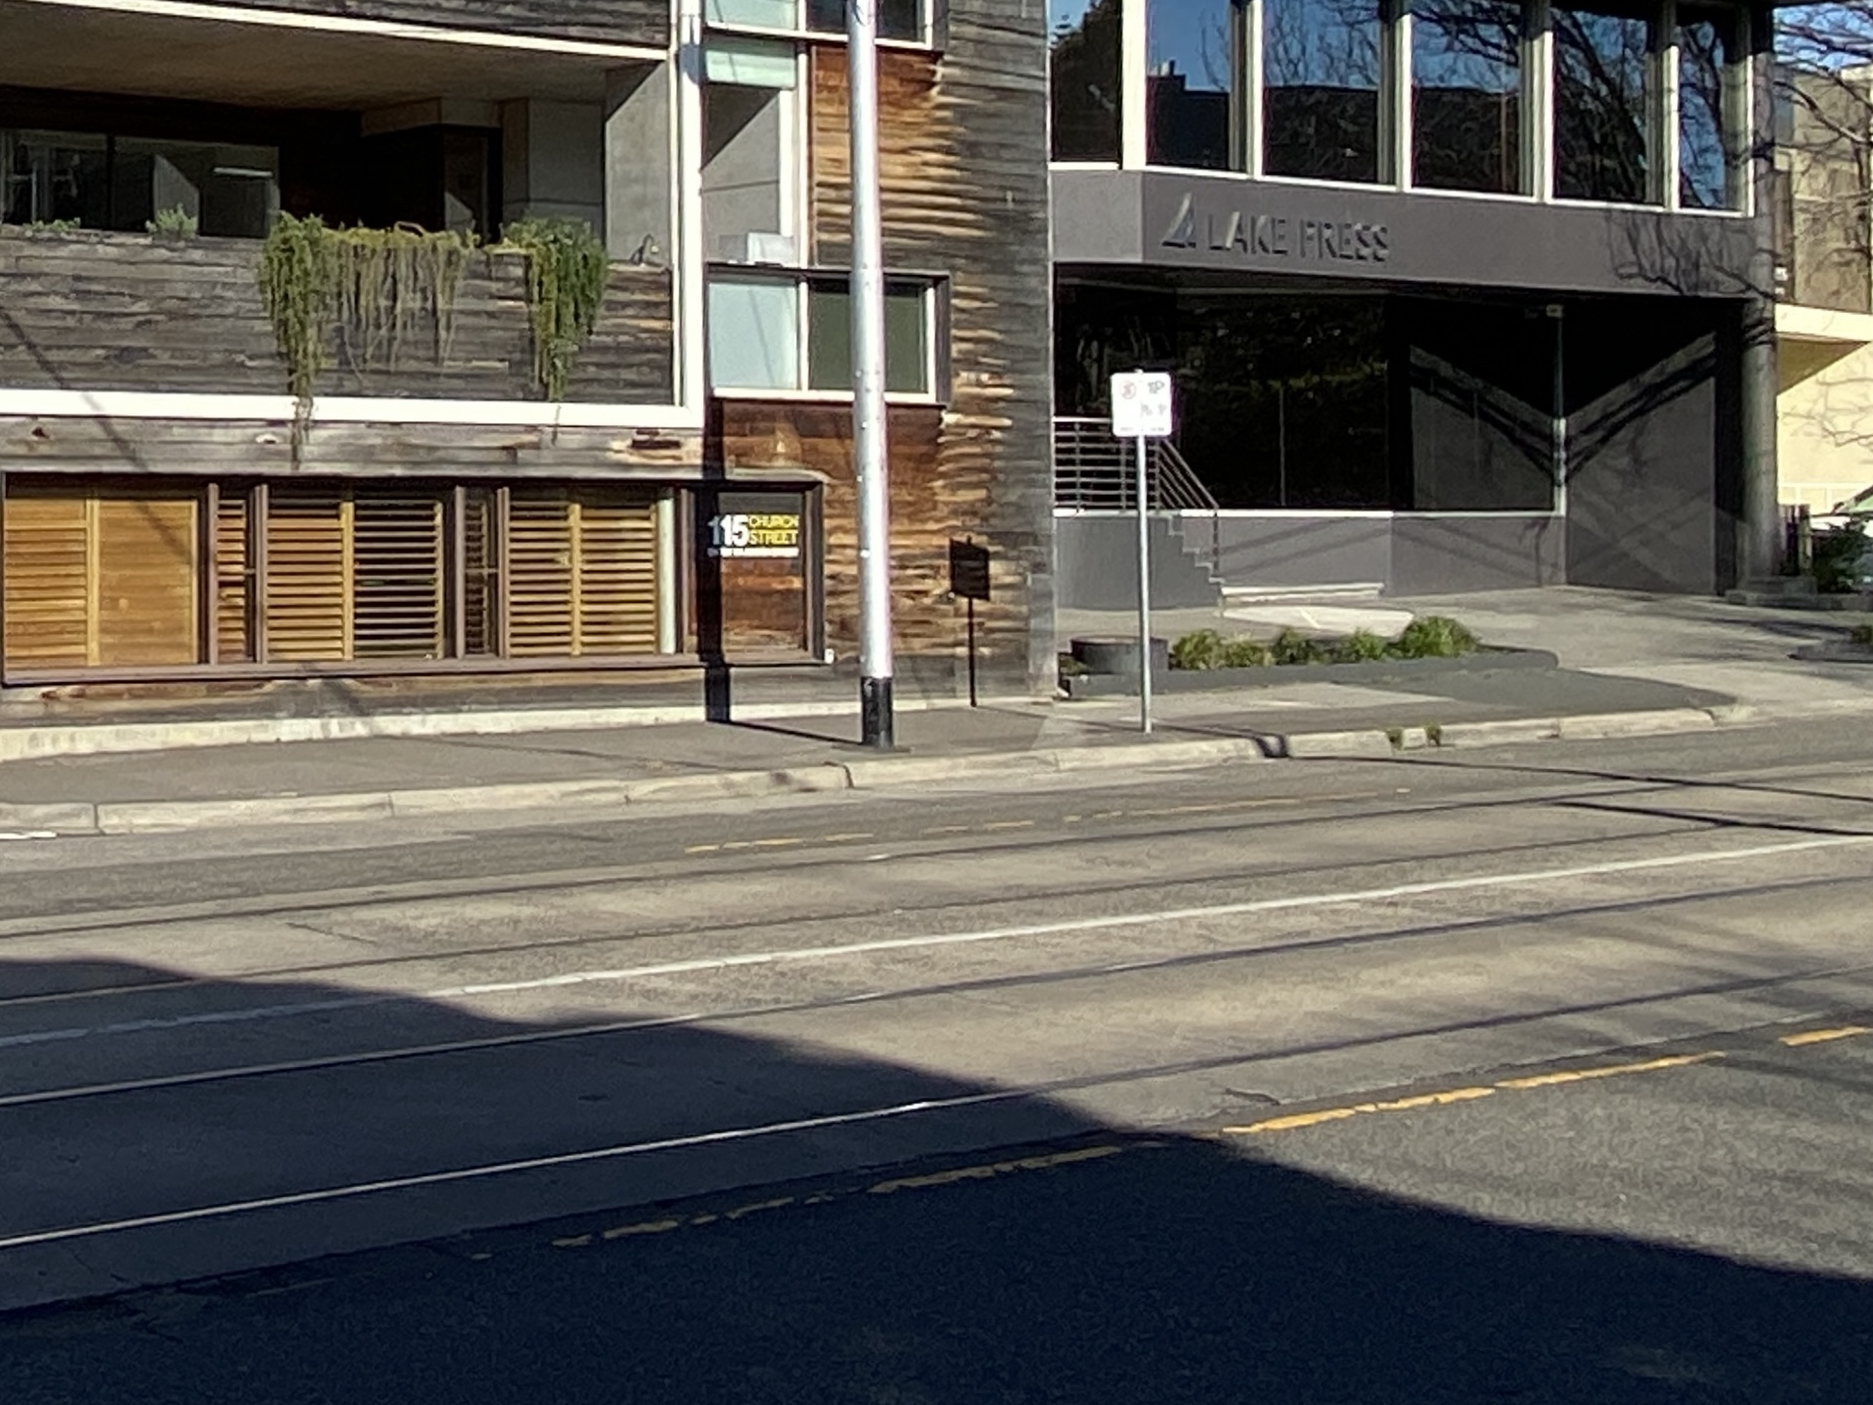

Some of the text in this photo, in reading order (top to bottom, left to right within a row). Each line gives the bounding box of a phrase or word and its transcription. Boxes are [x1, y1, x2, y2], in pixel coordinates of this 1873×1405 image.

[1207, 211, 1389, 263] LAKE PRESS
[707, 514, 749, 546] 115
[749, 514, 800, 528] CHURCH
[749, 529, 799, 545] STREET
